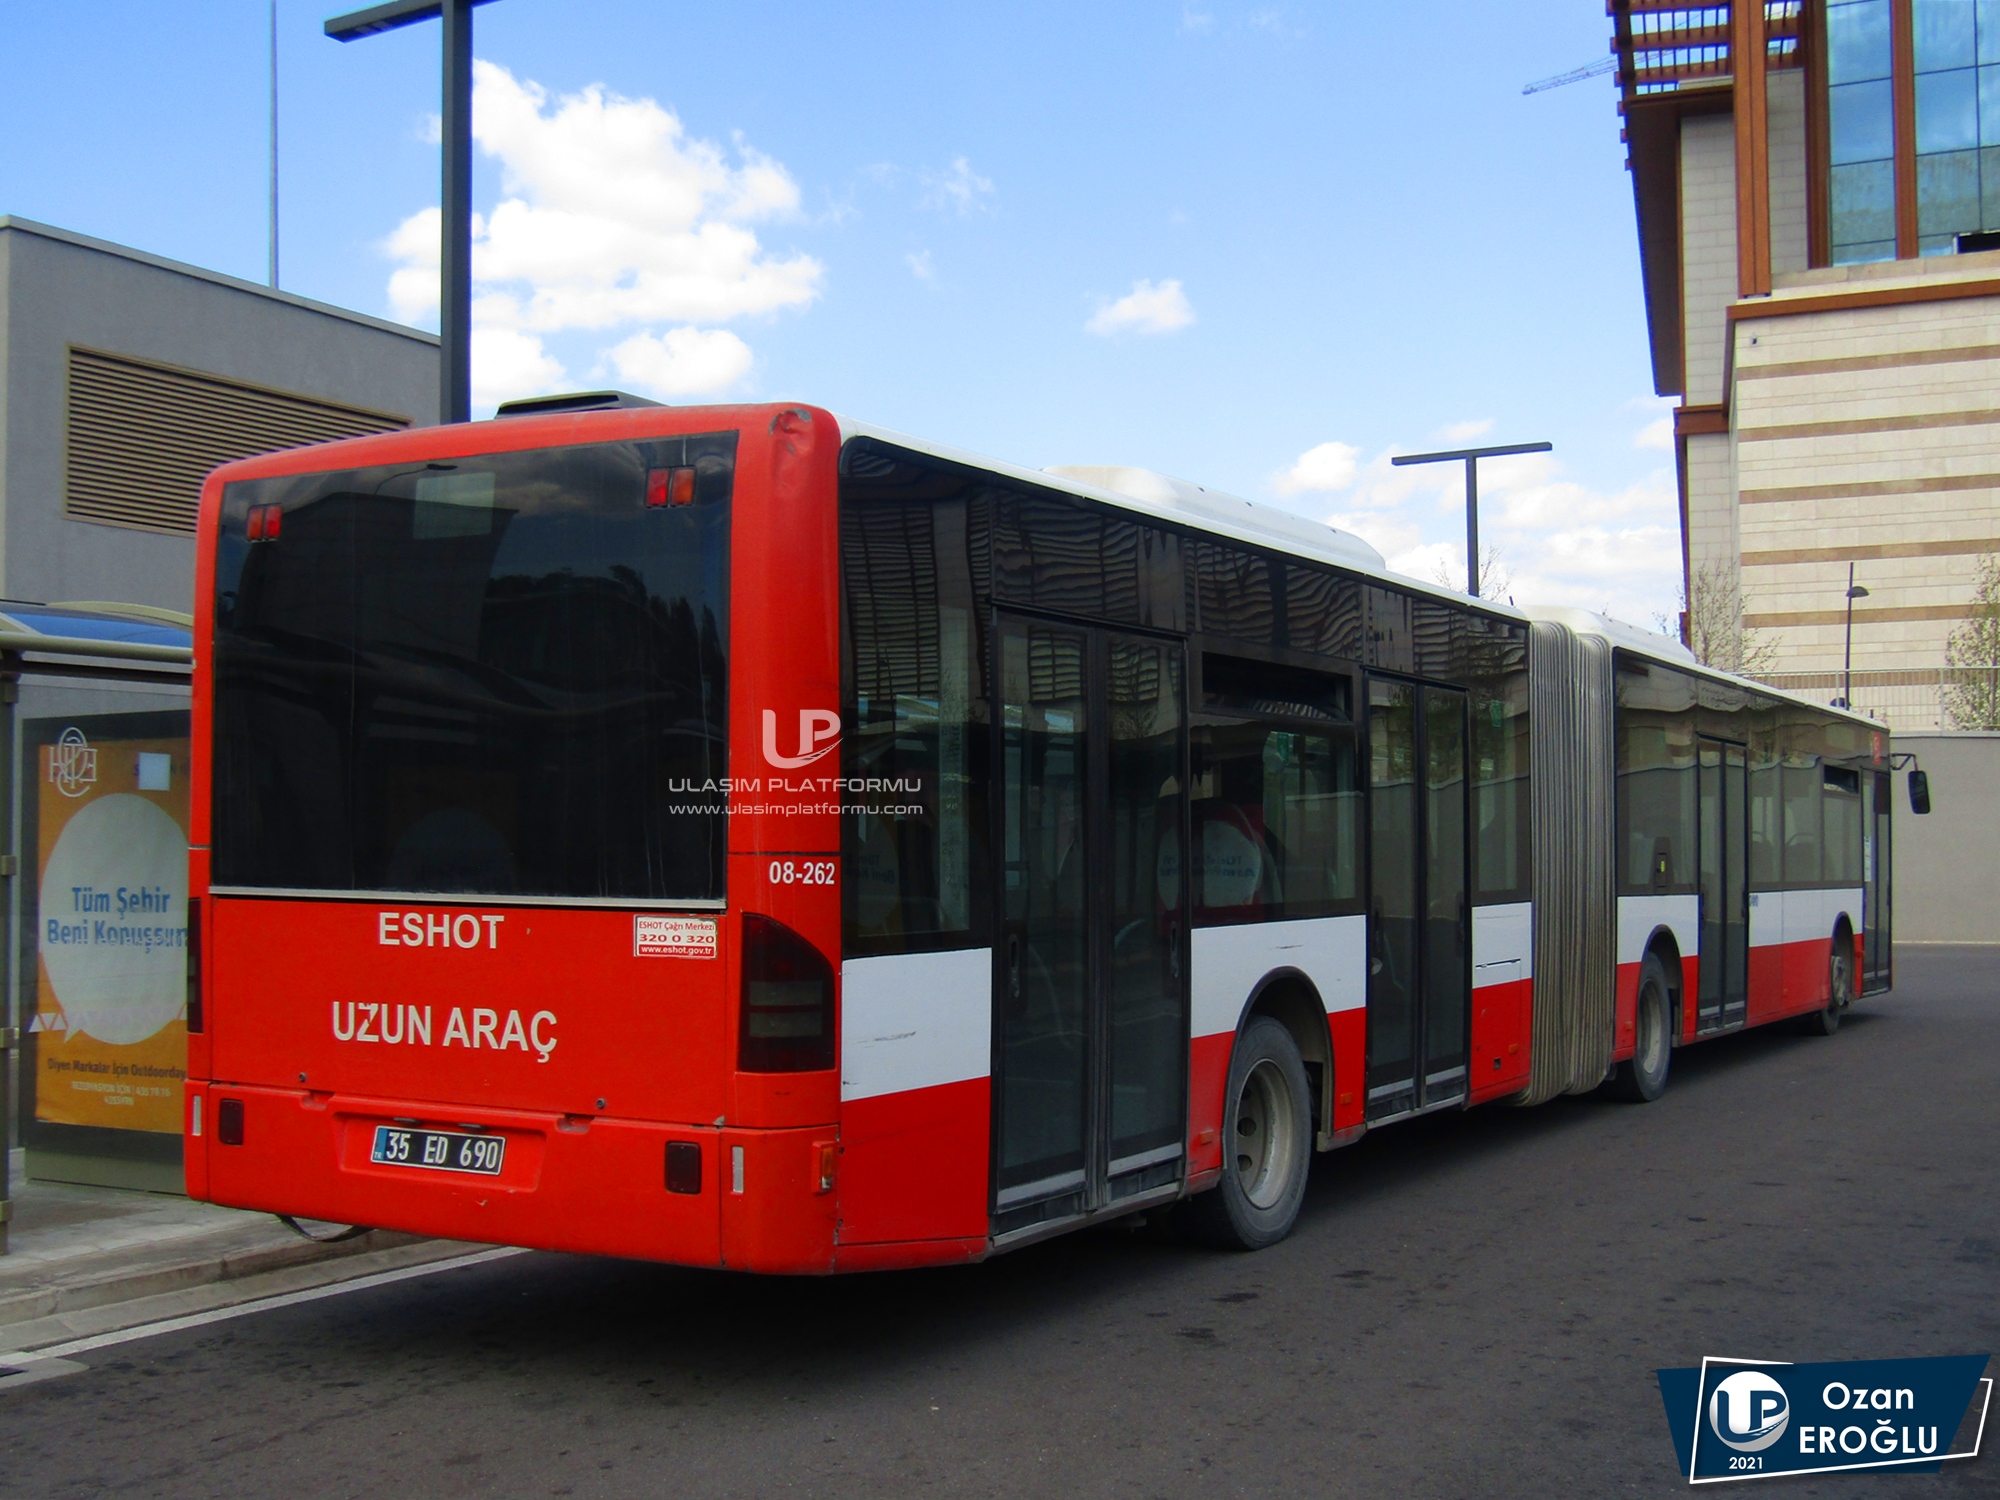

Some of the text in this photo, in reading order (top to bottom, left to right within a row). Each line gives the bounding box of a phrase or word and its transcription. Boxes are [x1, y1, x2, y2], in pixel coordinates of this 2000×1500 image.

[769, 860, 836, 885] 08-262
[71, 886, 171, 920] Tüm Şehir
[47, 919, 88, 945] Beni
[379, 911, 505, 949] ESHOT
[639, 921, 715, 931] ESHOT Çağrı Merkezi
[639, 933, 668, 942] 320
[686, 935, 715, 944] 320
[641, 946, 712, 955] www.eshot.gov.tr
[332, 1000, 558, 1063] UZUN ARAÇ
[386, 1132, 499, 1169] 35 ED 690
